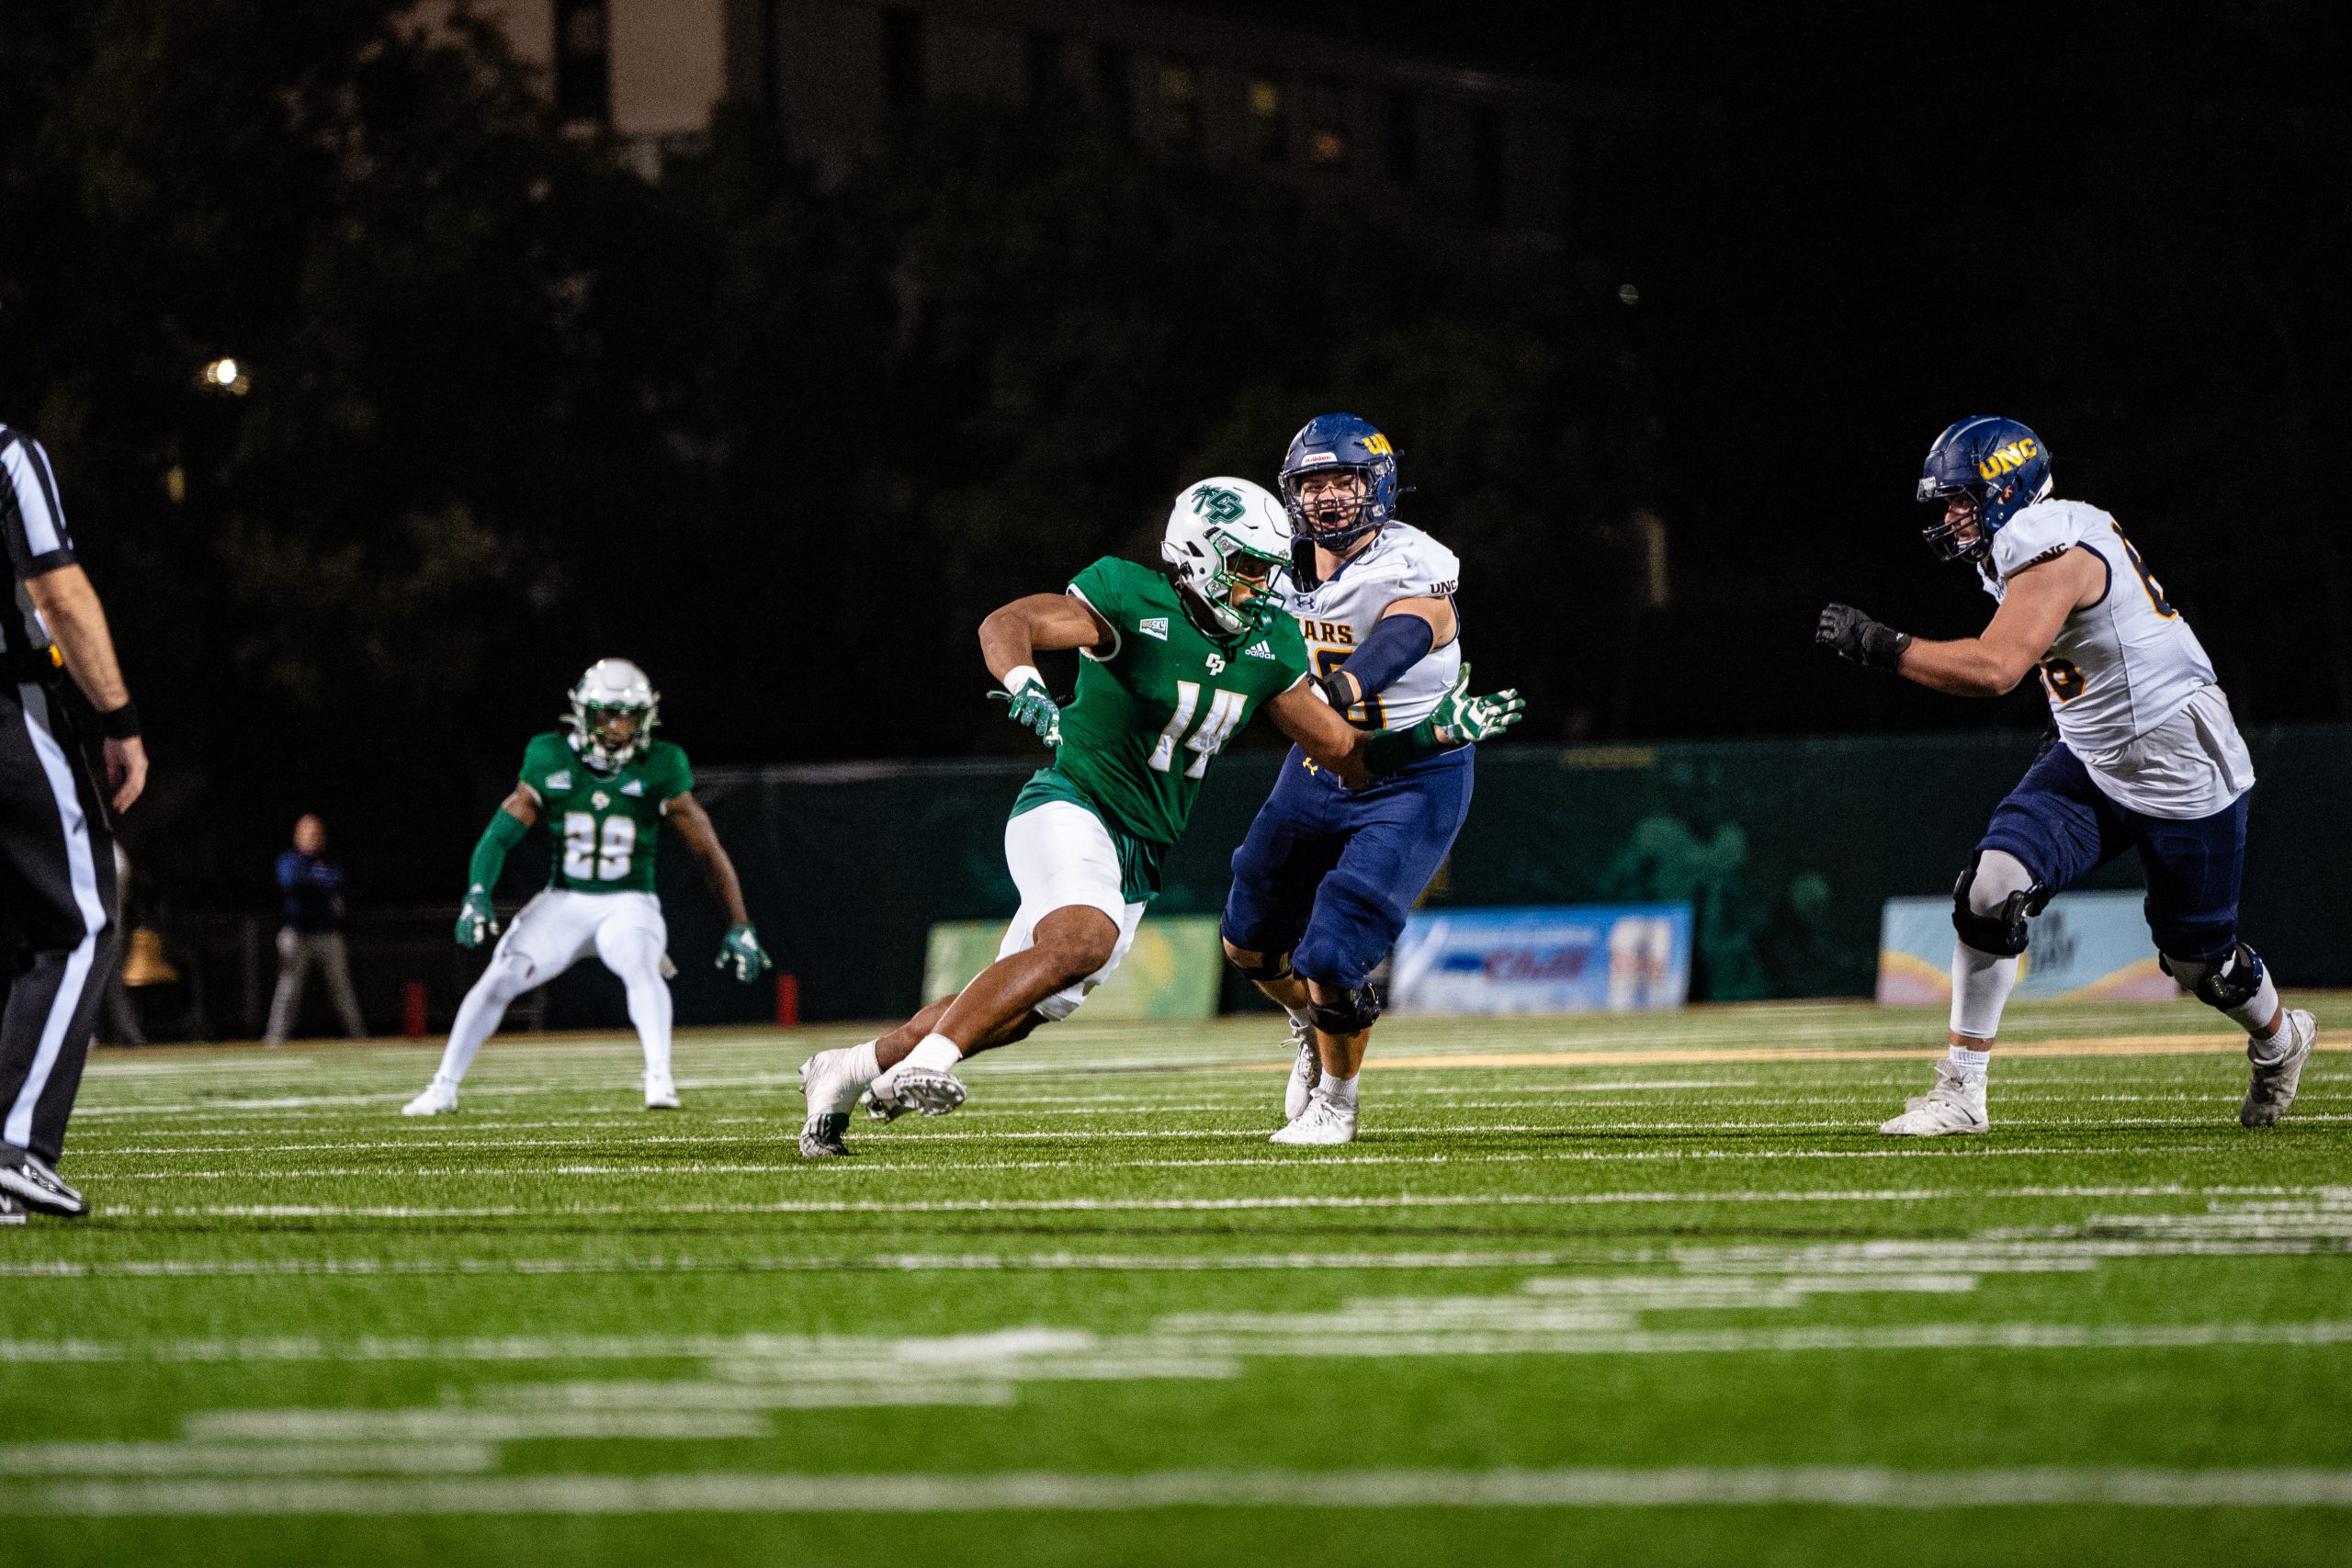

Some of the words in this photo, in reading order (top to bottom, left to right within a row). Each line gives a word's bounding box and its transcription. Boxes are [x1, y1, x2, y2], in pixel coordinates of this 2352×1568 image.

[1979, 437, 2038, 480] UNC
[1430, 579, 1457, 594] UNC
[1295, 616, 1354, 645] ARS
[1245, 649, 1276, 660] adidas
[1148, 680, 1249, 779] 14
